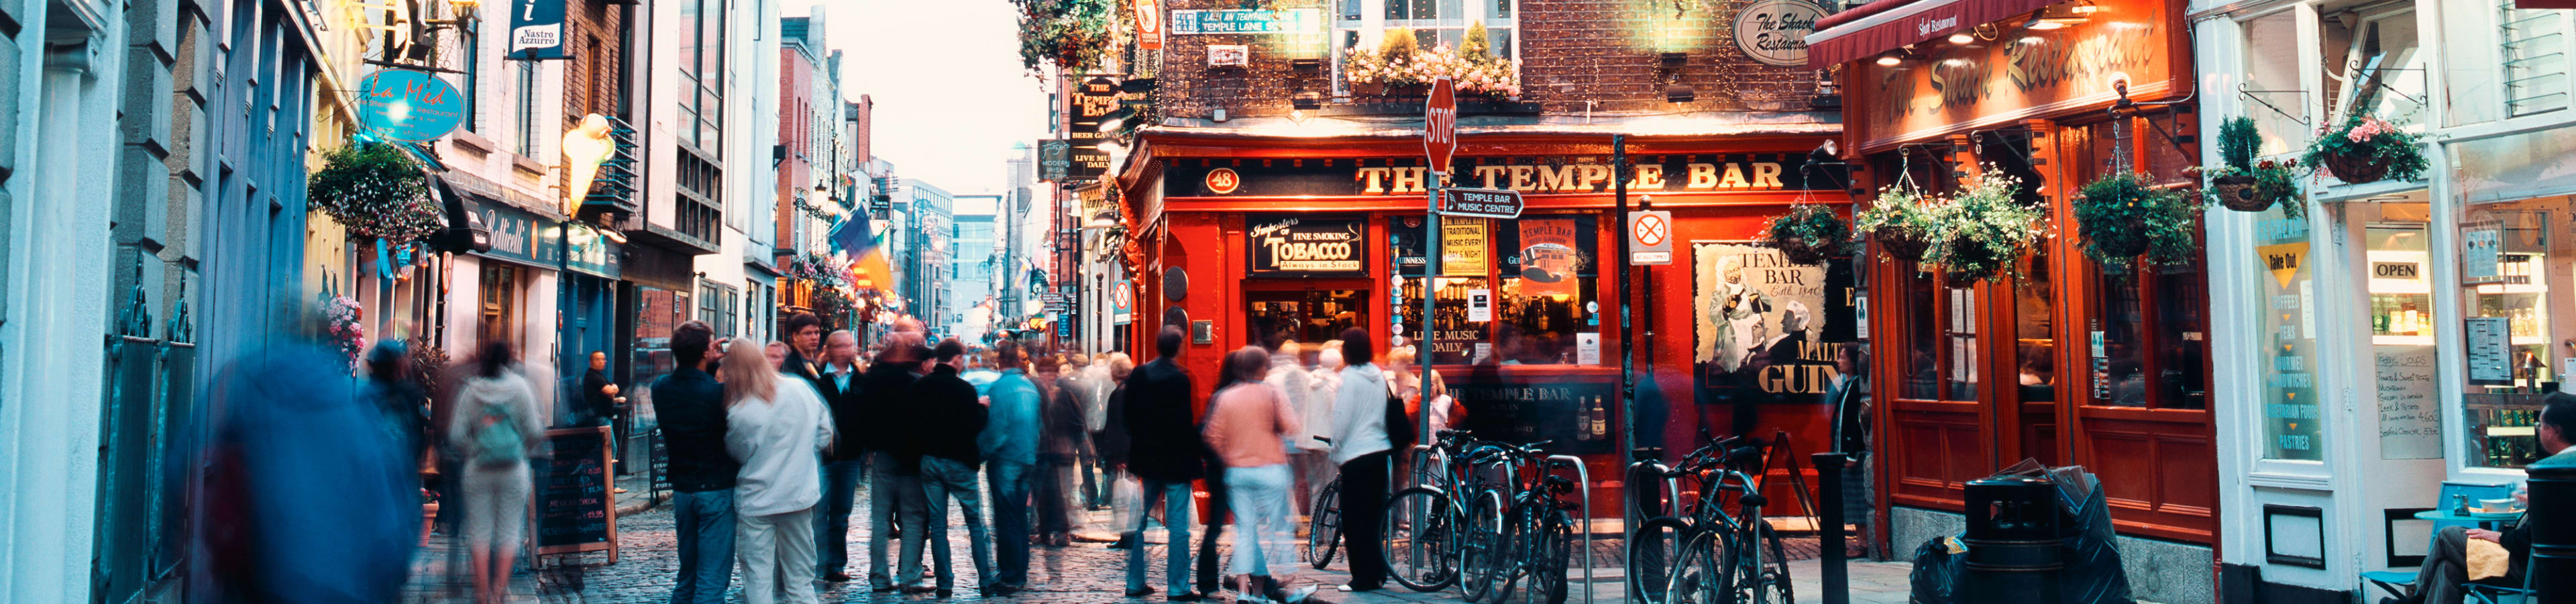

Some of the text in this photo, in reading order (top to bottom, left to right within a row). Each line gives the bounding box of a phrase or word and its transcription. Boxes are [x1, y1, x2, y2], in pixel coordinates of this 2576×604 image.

[1224, 13, 1234, 21] AN
[1756, 13, 1817, 32] The Shack
[525, 30, 553, 38] Nastro
[1202, 22, 1236, 32] TEMPLE
[1238, 22, 1263, 31] LANE
[519, 36, 555, 44] Azzurro
[1754, 33, 1809, 51] Restaura
[1882, 9, 2157, 124] The Shack Restaurant
[370, 74, 447, 105] La Med
[1089, 84, 1110, 92] THE
[1073, 93, 1112, 105] TEMP
[417, 106, 459, 118] Restaurant
[1427, 107, 1455, 144] STOP
[1212, 168, 1232, 187] 48
[1475, 163, 1666, 193] TEMPLE
[1687, 162, 1783, 191] BAR
[1463, 193, 1511, 203] TEMPLE BAR
[1457, 203, 1515, 213] MUSIC CENTRE
[484, 209, 526, 255] Botticelli
[1250, 217, 1299, 238] Importers
[1446, 227, 1481, 235] TRADITIONAL
[1523, 225, 1572, 238] TEMPLE BAR
[2255, 217, 2302, 241] ICE CREAM
[1313, 232, 1350, 241] SMOKING
[1464, 238, 1482, 246] EVERY
[1263, 237, 1351, 267] TOBACCO
[1448, 250, 1458, 258] DAY
[1464, 250, 1481, 258] NIGHT
[1282, 261, 1315, 269] Always
[1331, 260, 1358, 268] Stock
[1399, 256, 1426, 264] UINNESS
[2269, 252, 2297, 270] Take Out
[2376, 264, 2416, 276] OPEN
[1765, 269, 1805, 286] BAR
[1798, 286, 1821, 296] 1840
[2272, 294, 2300, 309] COFFEES
[1413, 330, 1480, 341] LIE MUSIC
[2279, 325, 2296, 340] TEAS
[1432, 342, 1462, 352] DAILY
[1796, 340, 1842, 362] MALT
[2273, 356, 2303, 371] GOURMET
[1758, 364, 1842, 394] GUIN
[2269, 373, 2312, 388] SANDWICHES
[1445, 387, 1571, 401] HE TEMPLE BAR
[2266, 403, 2320, 419] VEGETARIAN FOODS
[2279, 434, 2310, 450] PASTRIES
